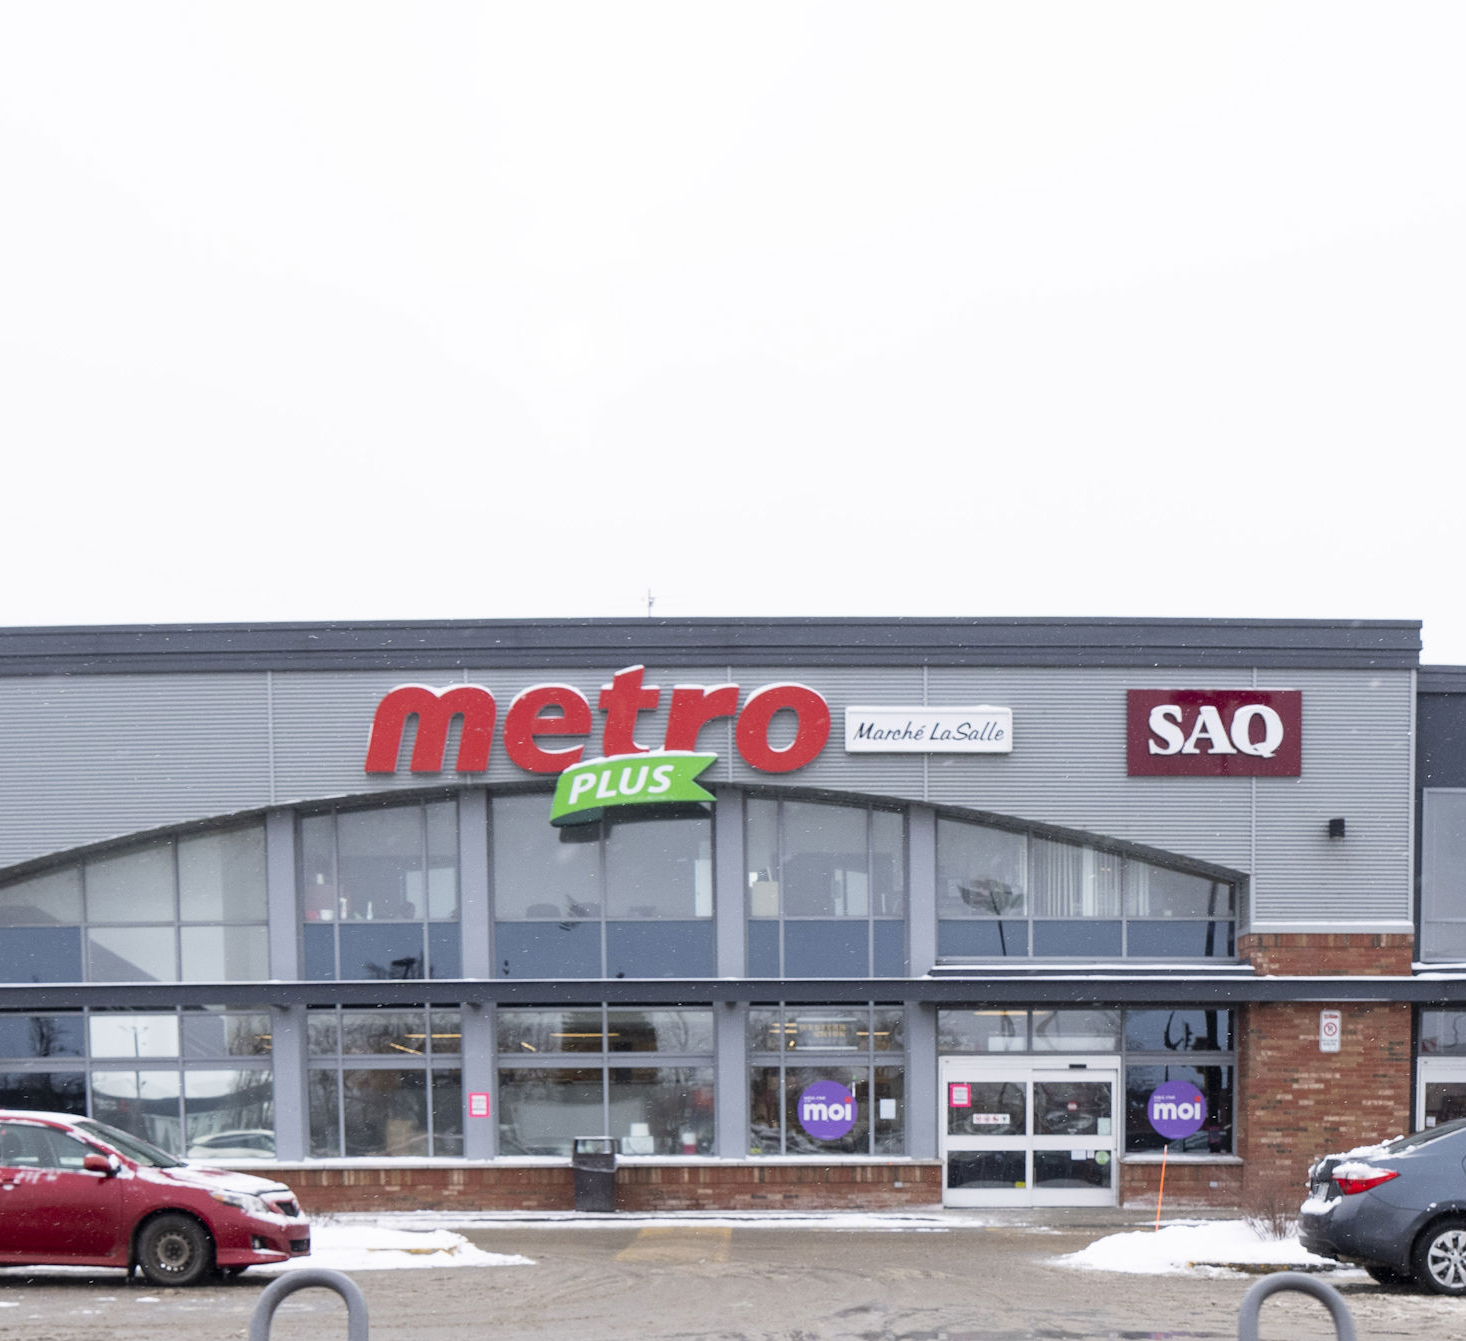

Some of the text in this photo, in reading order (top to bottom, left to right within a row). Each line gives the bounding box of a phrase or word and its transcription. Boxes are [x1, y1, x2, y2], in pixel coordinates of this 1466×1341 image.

[364, 664, 832, 773] metro
[854, 721, 927, 741] Marché
[1148, 704, 1284, 758] SAQ
[567, 763, 675, 805] PLUS
[803, 1096, 852, 1121] moi
[1153, 1095, 1201, 1120] moi
